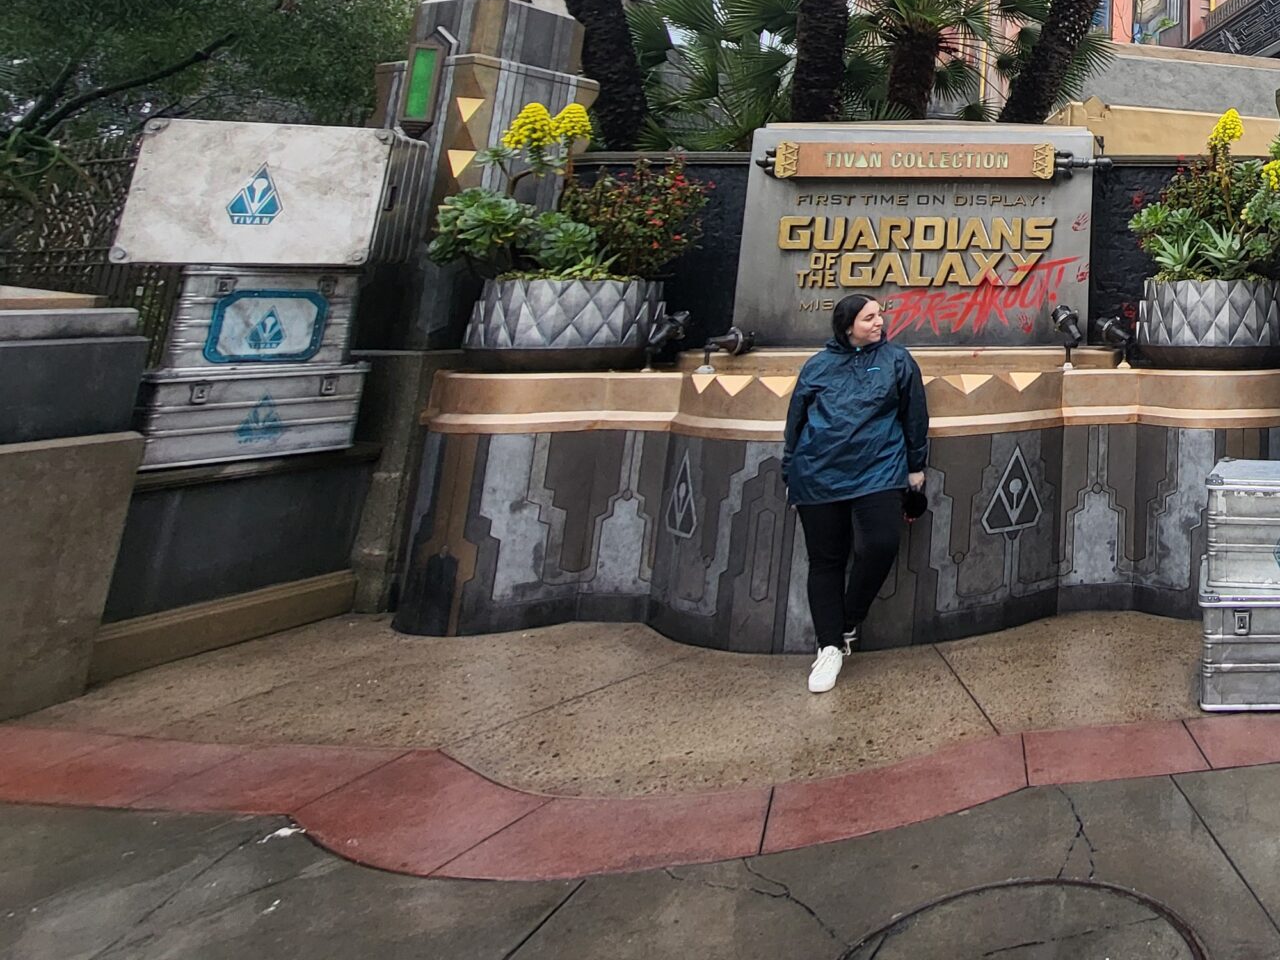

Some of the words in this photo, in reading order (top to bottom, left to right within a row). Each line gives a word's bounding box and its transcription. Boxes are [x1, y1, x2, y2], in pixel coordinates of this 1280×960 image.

[824, 151, 882, 168] TIVAN
[890, 152, 1009, 169] COLLECTION
[797, 194, 857, 206] FIRST
[861, 194, 910, 206] TIME
[916, 194, 946, 206] ON
[953, 194, 1047, 207] DISPLAY:
[232, 216, 272, 224] TIVAN
[778, 215, 1057, 251] GUARDIANS
[810, 252, 839, 270] OF
[839, 252, 1045, 288] GALAXY
[797, 270, 839, 288] THE
